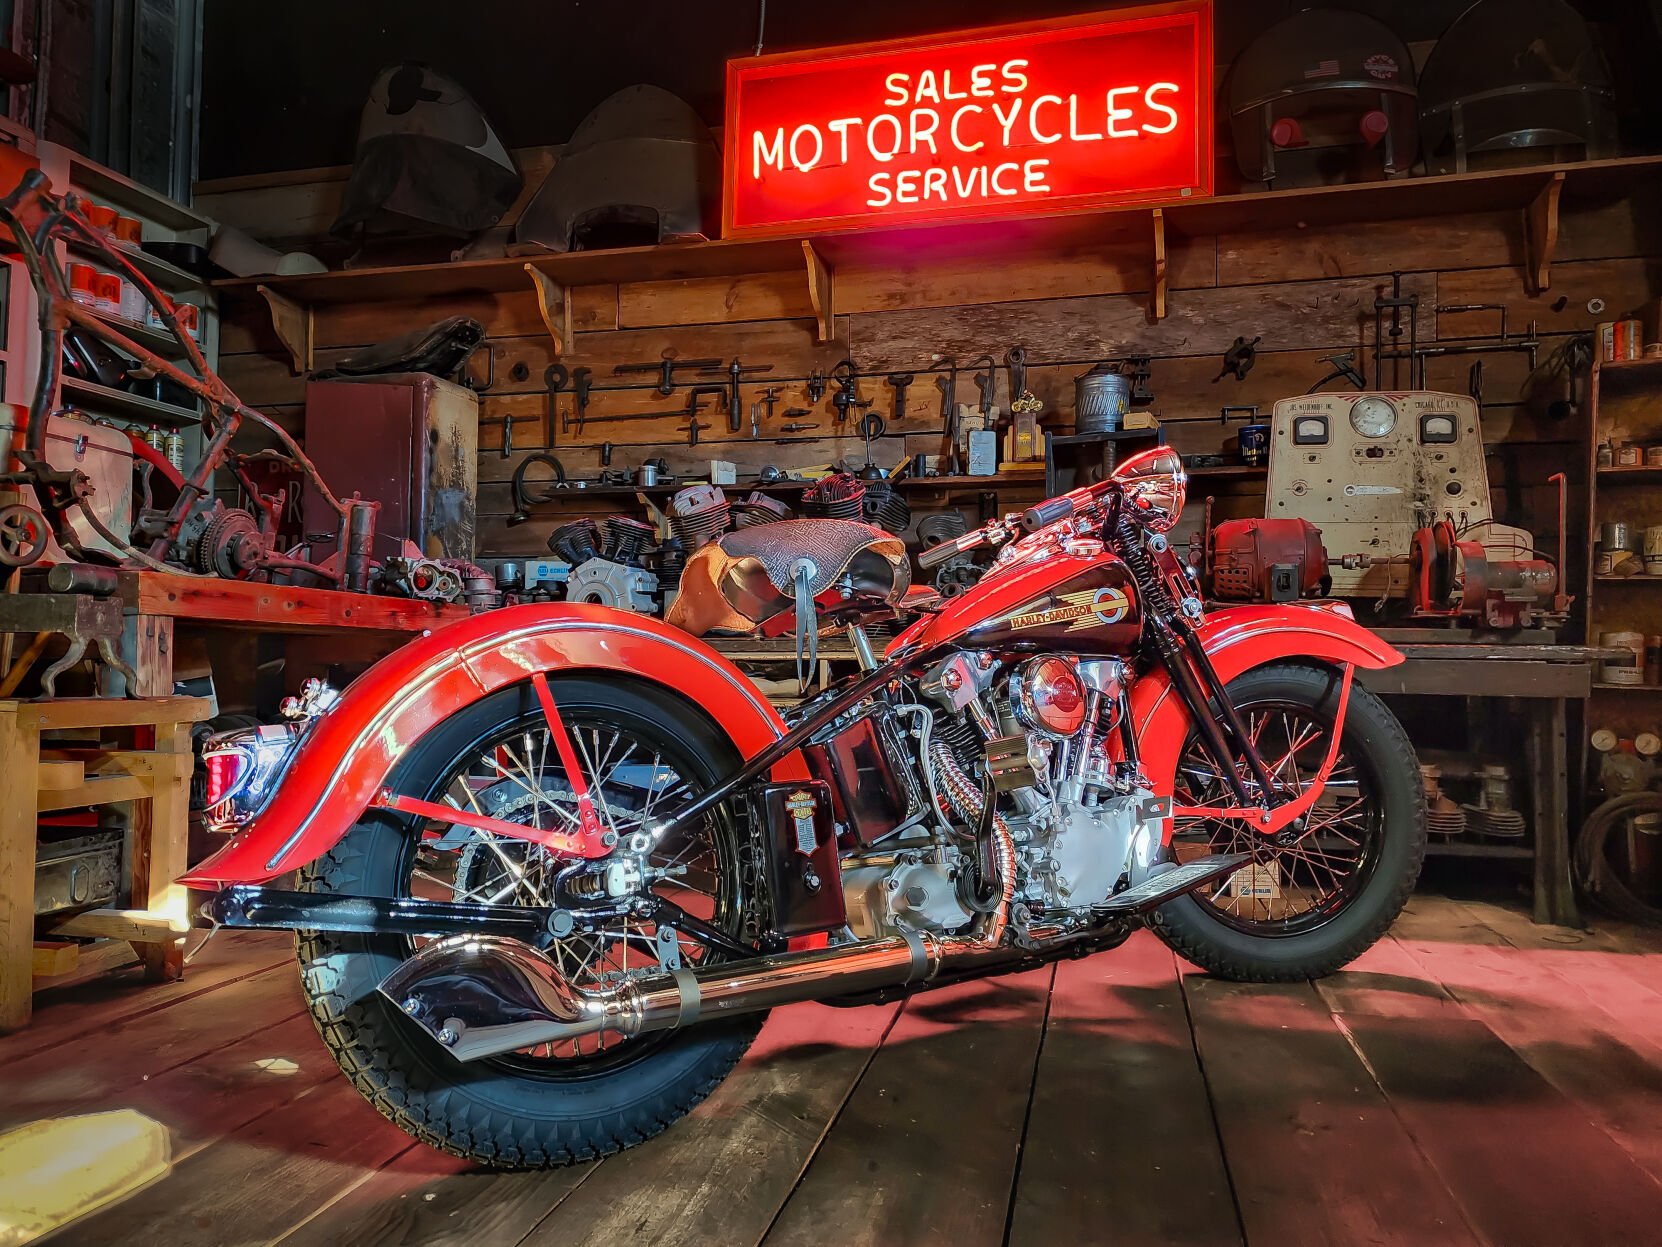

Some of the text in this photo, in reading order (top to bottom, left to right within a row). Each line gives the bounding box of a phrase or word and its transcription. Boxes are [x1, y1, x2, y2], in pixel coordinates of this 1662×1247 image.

[884, 58, 1029, 107] SALES
[752, 82, 1180, 180] MOTORCYCLES
[866, 158, 1051, 208] SERVICE
[1012, 605, 1092, 628] HARLEY-DAVIDSON
